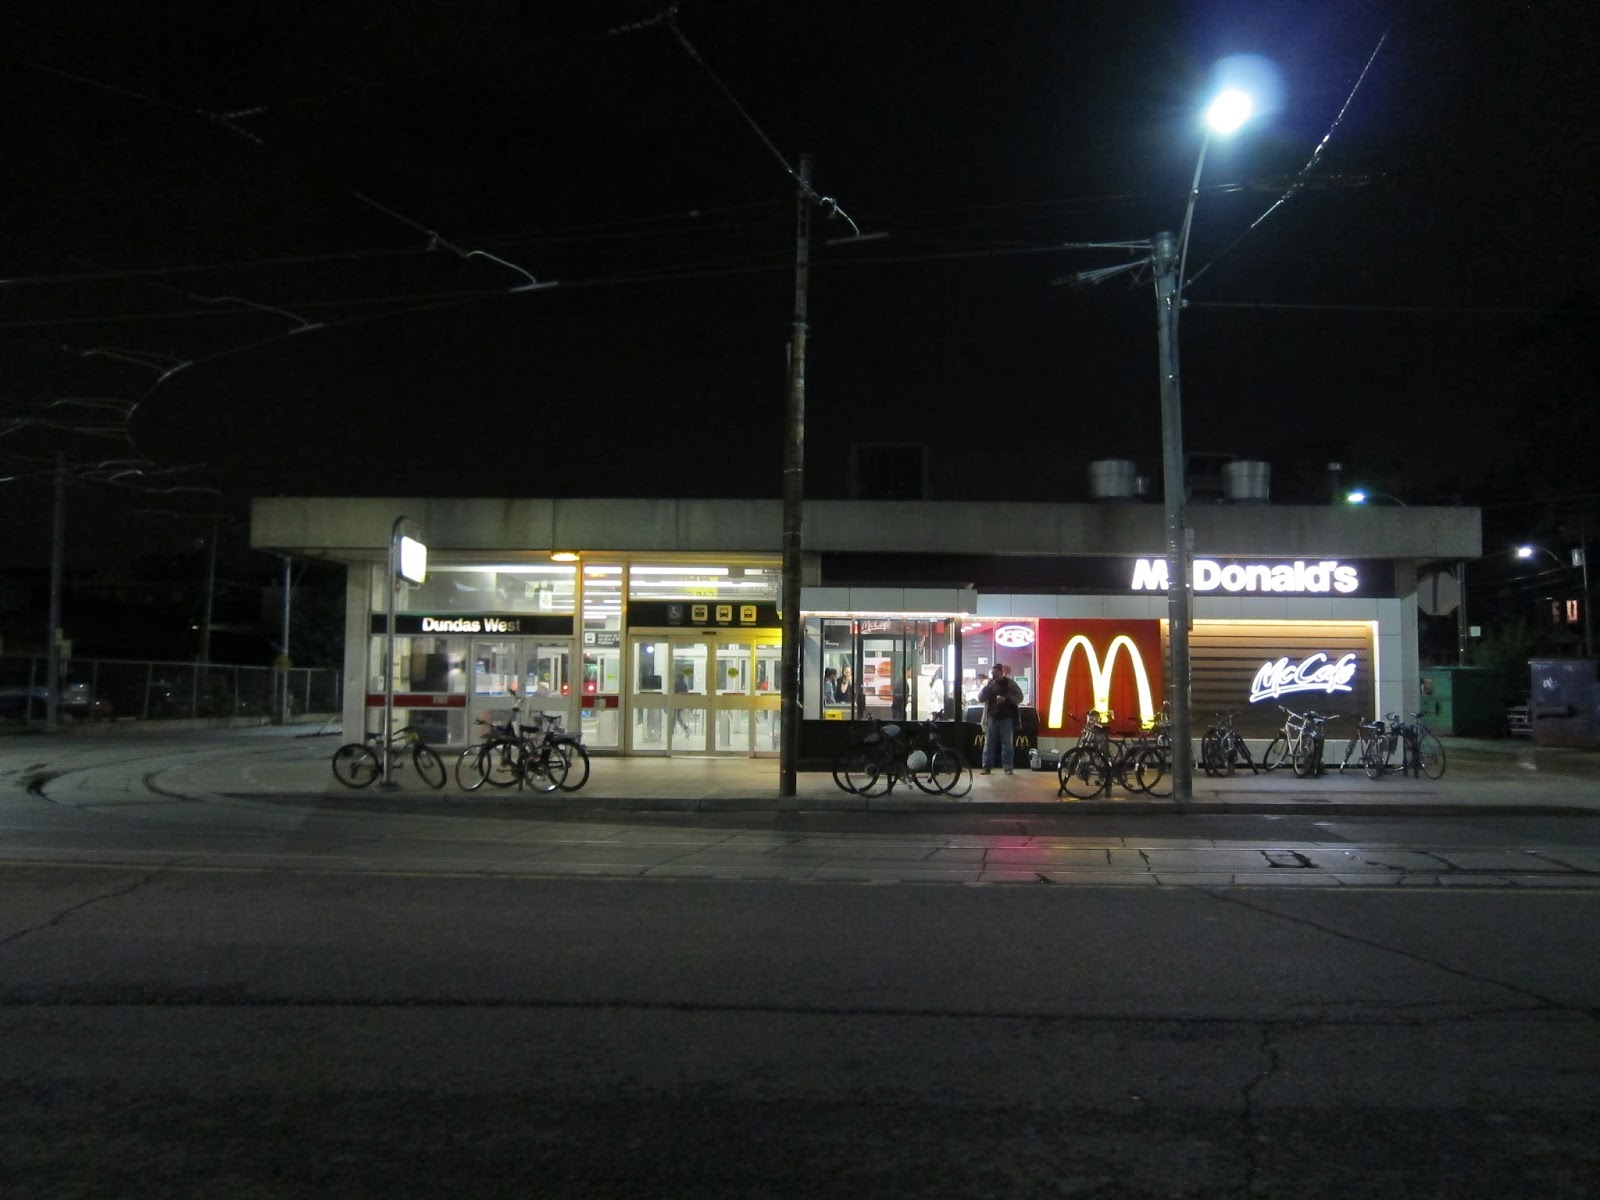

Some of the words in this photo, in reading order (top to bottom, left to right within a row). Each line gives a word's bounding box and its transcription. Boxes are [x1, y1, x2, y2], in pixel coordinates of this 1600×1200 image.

[1131, 559, 1359, 593] MDonald's
[422, 617, 481, 632] Dundas
[484, 618, 520, 632] West
[996, 629, 1034, 643] OPEN
